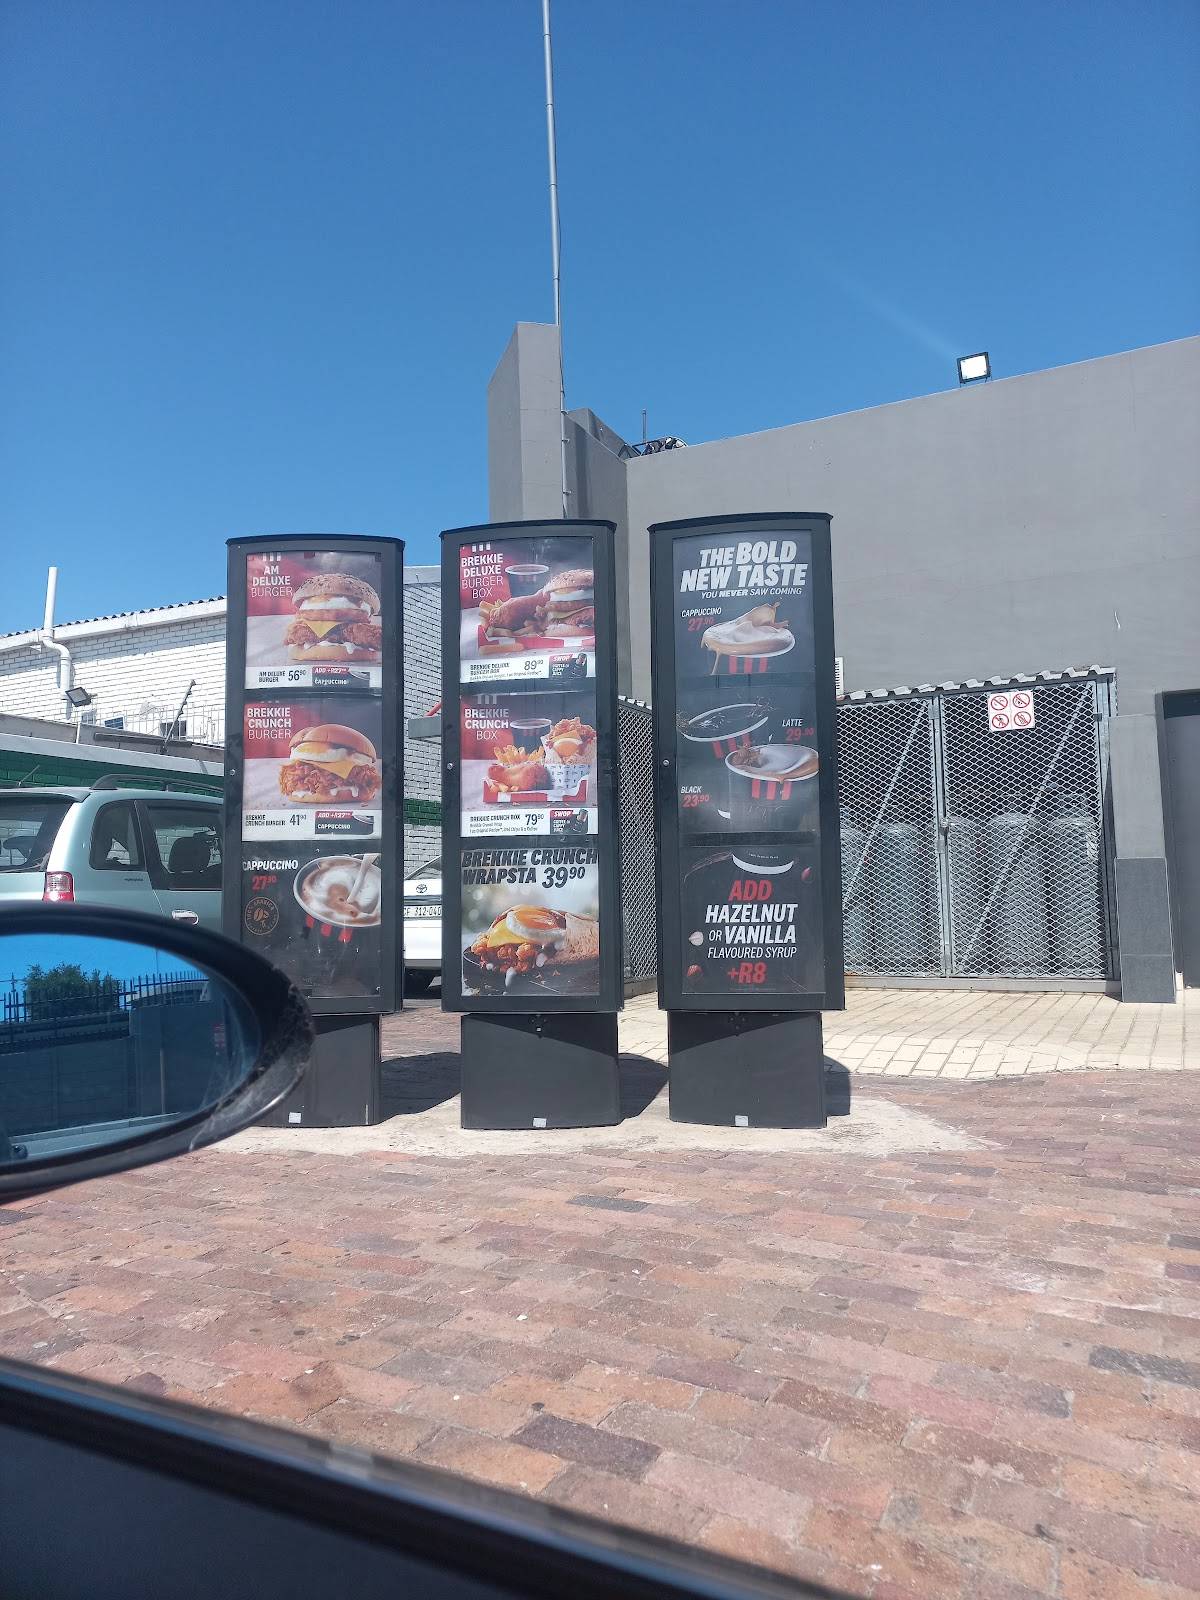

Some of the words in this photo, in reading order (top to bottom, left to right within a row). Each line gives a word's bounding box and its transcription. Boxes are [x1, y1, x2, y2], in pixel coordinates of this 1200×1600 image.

[700, 547, 736, 568] THE
[736, 541, 797, 565] BOLD
[461, 554, 503, 568] BREKKIE
[264, 566, 279, 575] AM
[464, 564, 501, 578] DELUXE
[252, 576, 290, 586] DELUXE
[462, 576, 504, 589] BURGER
[680, 567, 732, 592] NEW
[738, 564, 808, 588] TASTE
[251, 586, 293, 598] BURGER
[472, 587, 492, 598] BOX
[701, 591, 718, 599] YOU
[718, 589, 748, 598] NEVER
[750, 588, 768, 596] SAW
[770, 587, 802, 595] COMING
[681, 607, 722, 618] CAPPUCCINO
[247, 708, 290, 718] BREKKIE
[464, 708, 509, 718] BREKKIE
[248, 719, 292, 728] CRUNCH
[464, 720, 509, 729] CRUNCH
[782, 718, 803, 727] LATTE
[248, 729, 292, 739] BURGER
[476, 730, 498, 740] BOX
[680, 786, 702, 794] BLACK
[462, 850, 527, 867] BREKKIE
[530, 848, 597, 866] CRUNCH
[242, 860, 298, 870] CAPPUCCINO
[462, 868, 536, 884] WRAPSTA
[728, 880, 773, 901] ADD
[705, 904, 798, 923] HAZELNUT
[708, 930, 722, 942] OR
[724, 925, 796, 944] VANILLA
[708, 947, 764, 958] FLAVOURED
[765, 946, 797, 958] SYRUP
[728, 962, 767, 984] +R8
